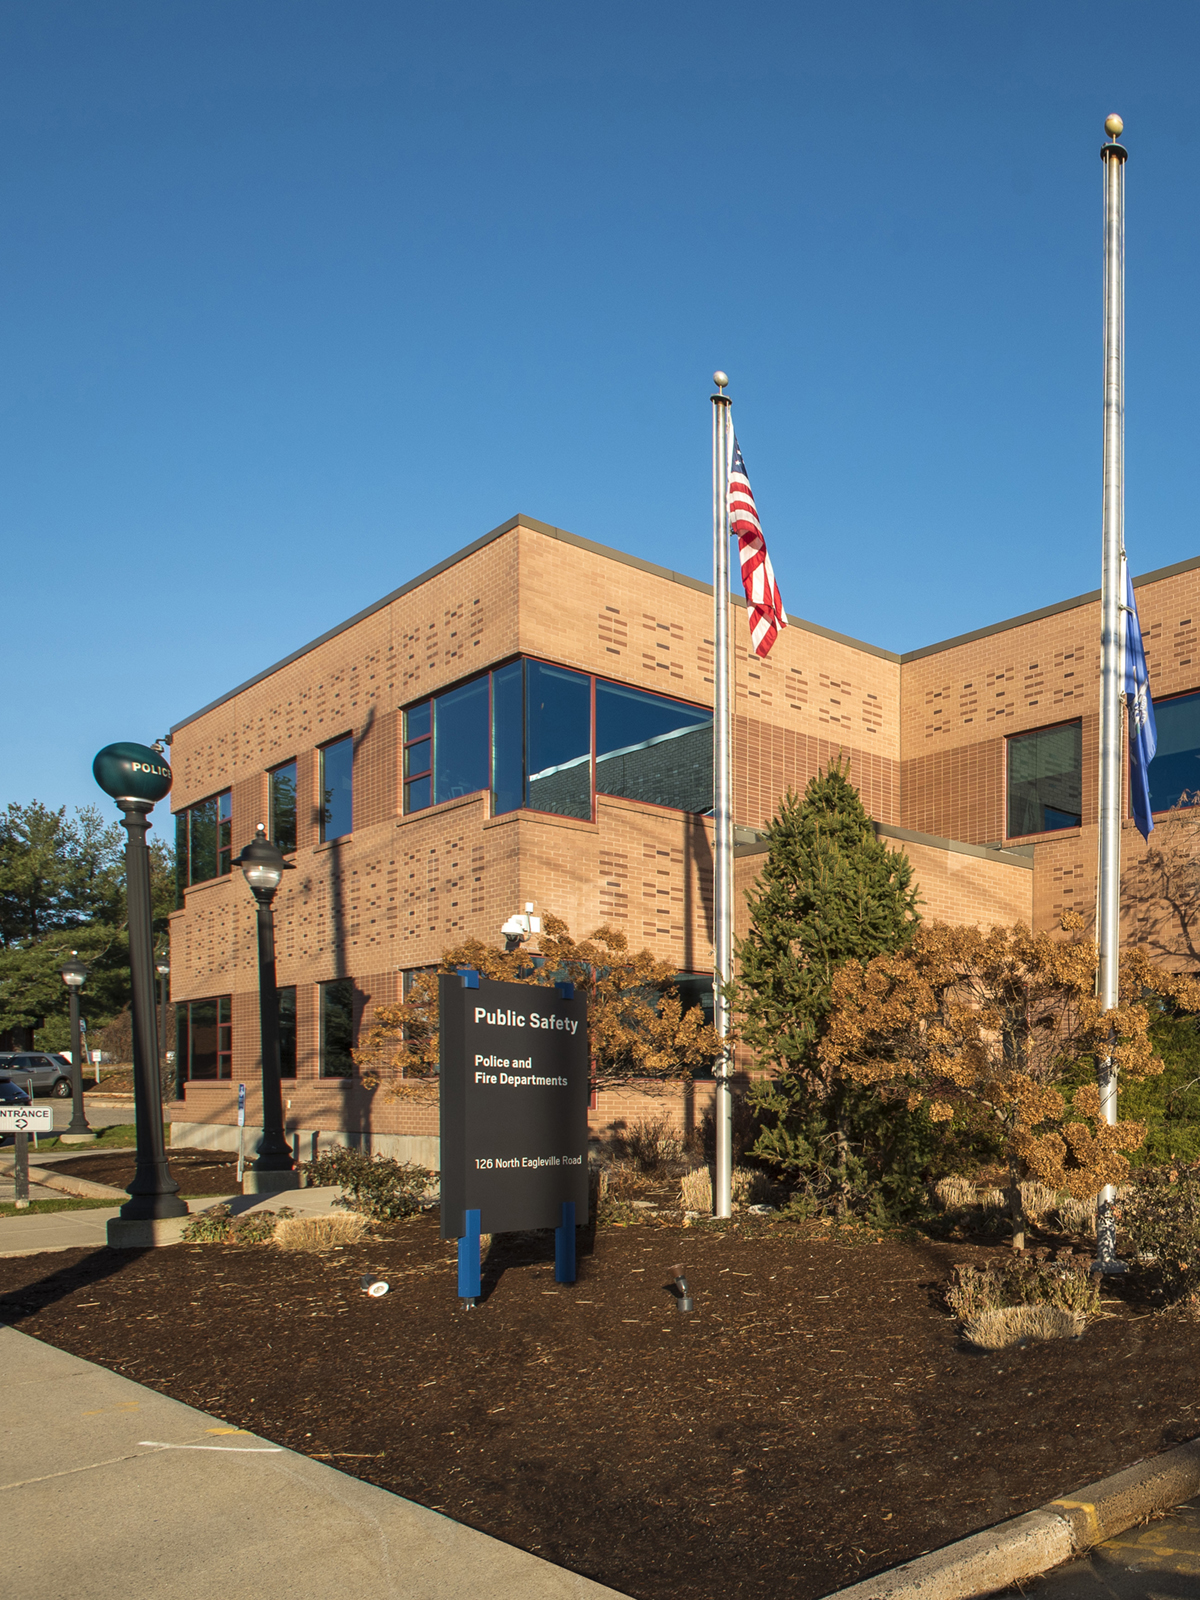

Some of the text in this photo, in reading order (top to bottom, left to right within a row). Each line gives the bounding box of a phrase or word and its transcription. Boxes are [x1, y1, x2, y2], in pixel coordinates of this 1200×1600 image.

[131, 761, 172, 779] POLICE
[474, 1007, 579, 1035] Public Safety
[474, 1054, 532, 1069] Police and
[474, 1071, 568, 1088] Fire Departments
[0, 1110, 49, 1118] NTRANCE
[475, 1155, 582, 1170] 126 North Eagleville Road
